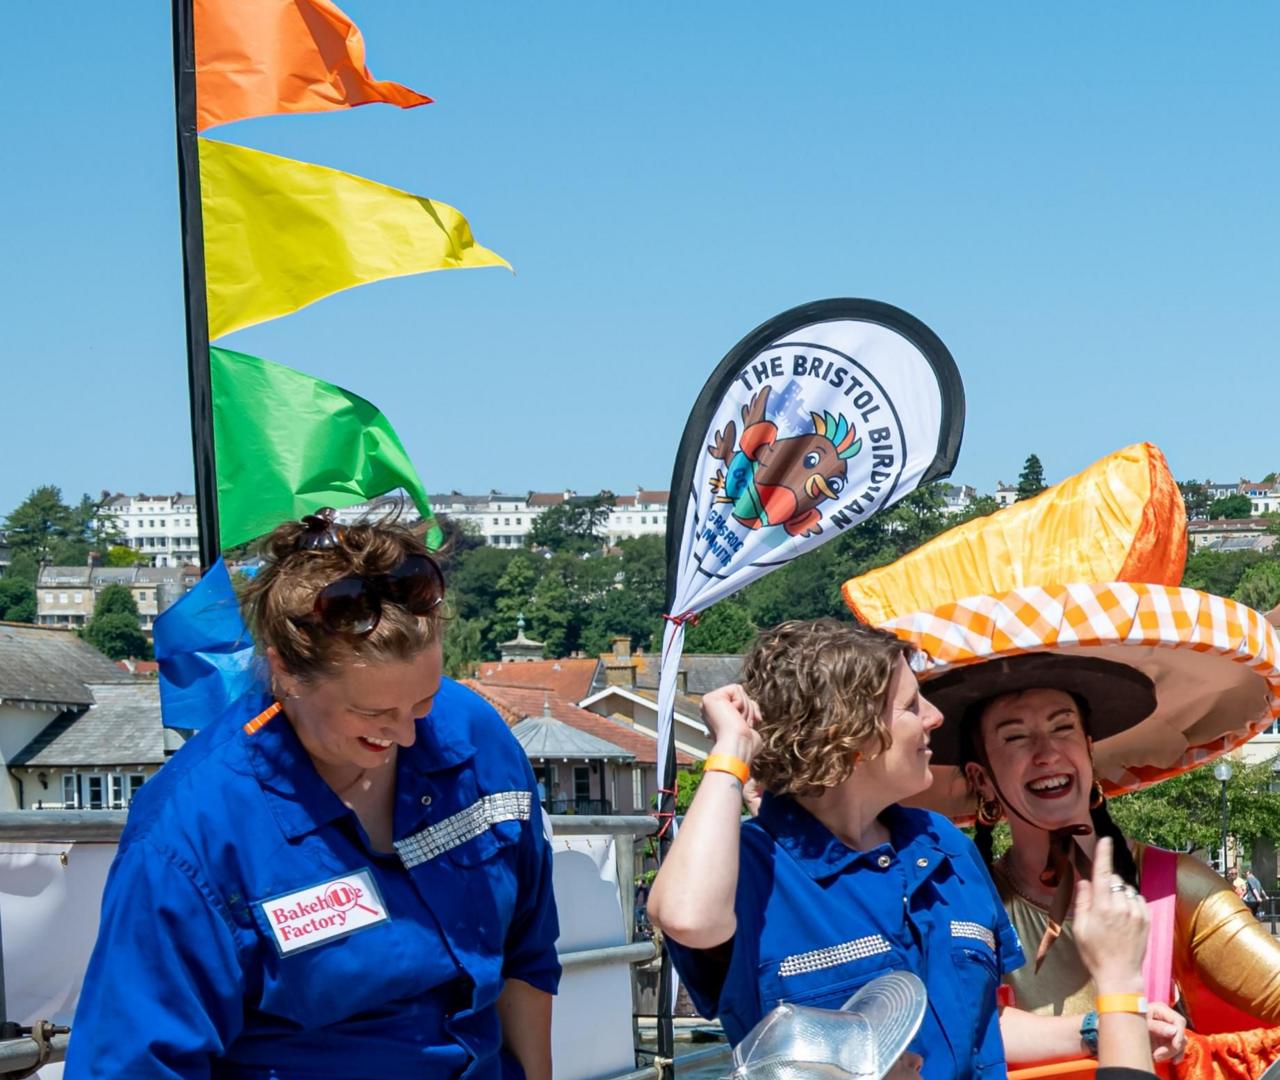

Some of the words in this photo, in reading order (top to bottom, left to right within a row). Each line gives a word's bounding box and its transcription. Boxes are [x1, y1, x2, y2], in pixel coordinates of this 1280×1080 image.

[735, 355, 784, 391] THE
[793, 354, 881, 424] BRISTOL
[279, 911, 347, 942] Factory
